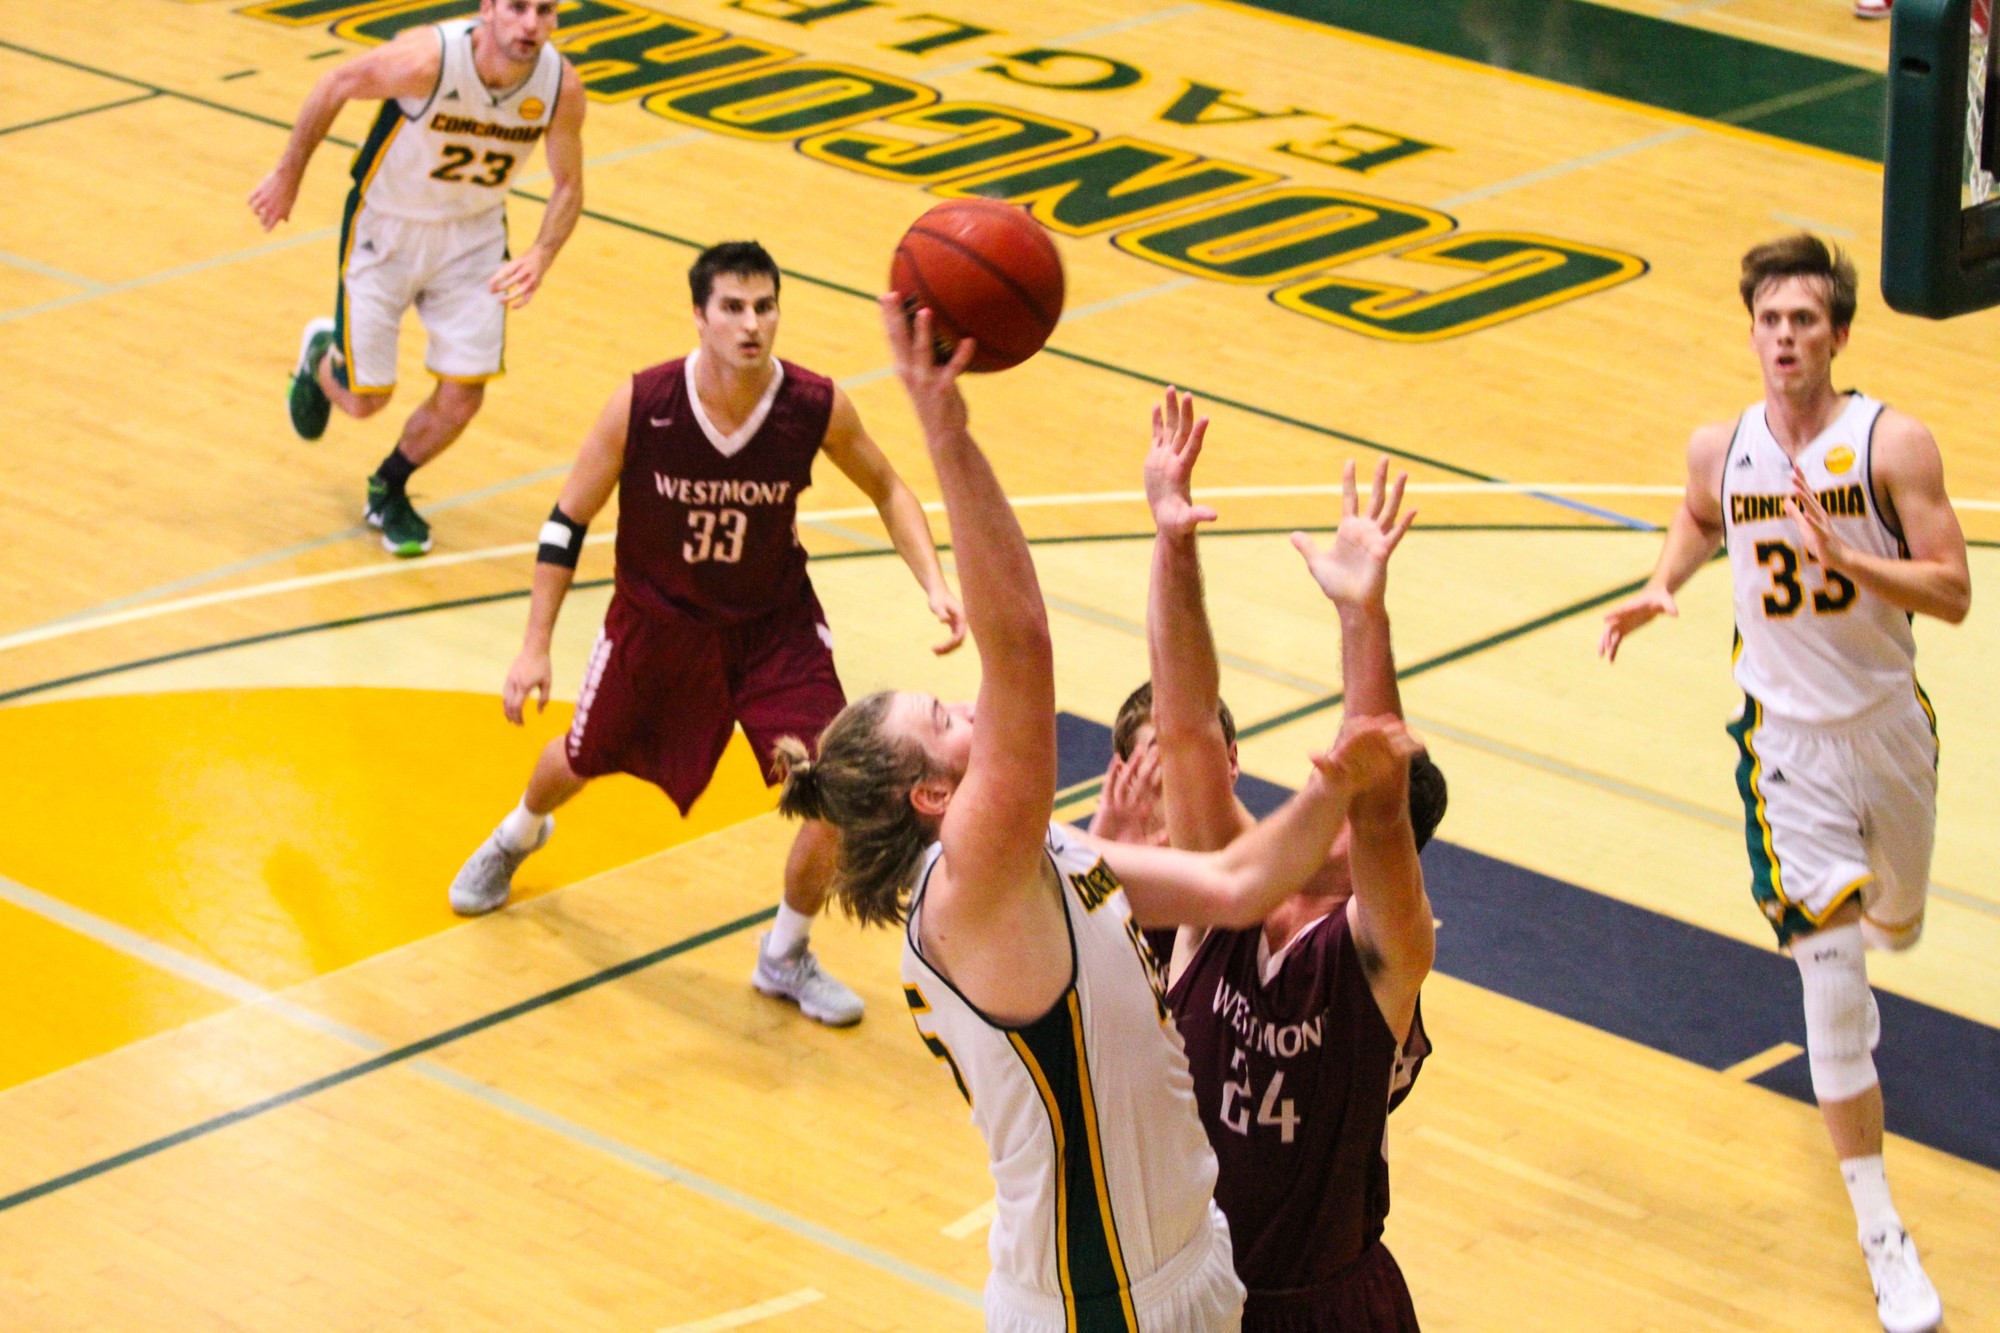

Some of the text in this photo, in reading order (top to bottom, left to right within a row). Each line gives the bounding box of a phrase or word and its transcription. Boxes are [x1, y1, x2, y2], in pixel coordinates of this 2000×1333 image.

[429, 144, 515, 187] 23
[654, 471, 791, 505] WESTMONT
[1730, 481, 1867, 525] CONCDIA
[682, 508, 747, 564] 33
[1220, 1047, 1300, 1143] 24
